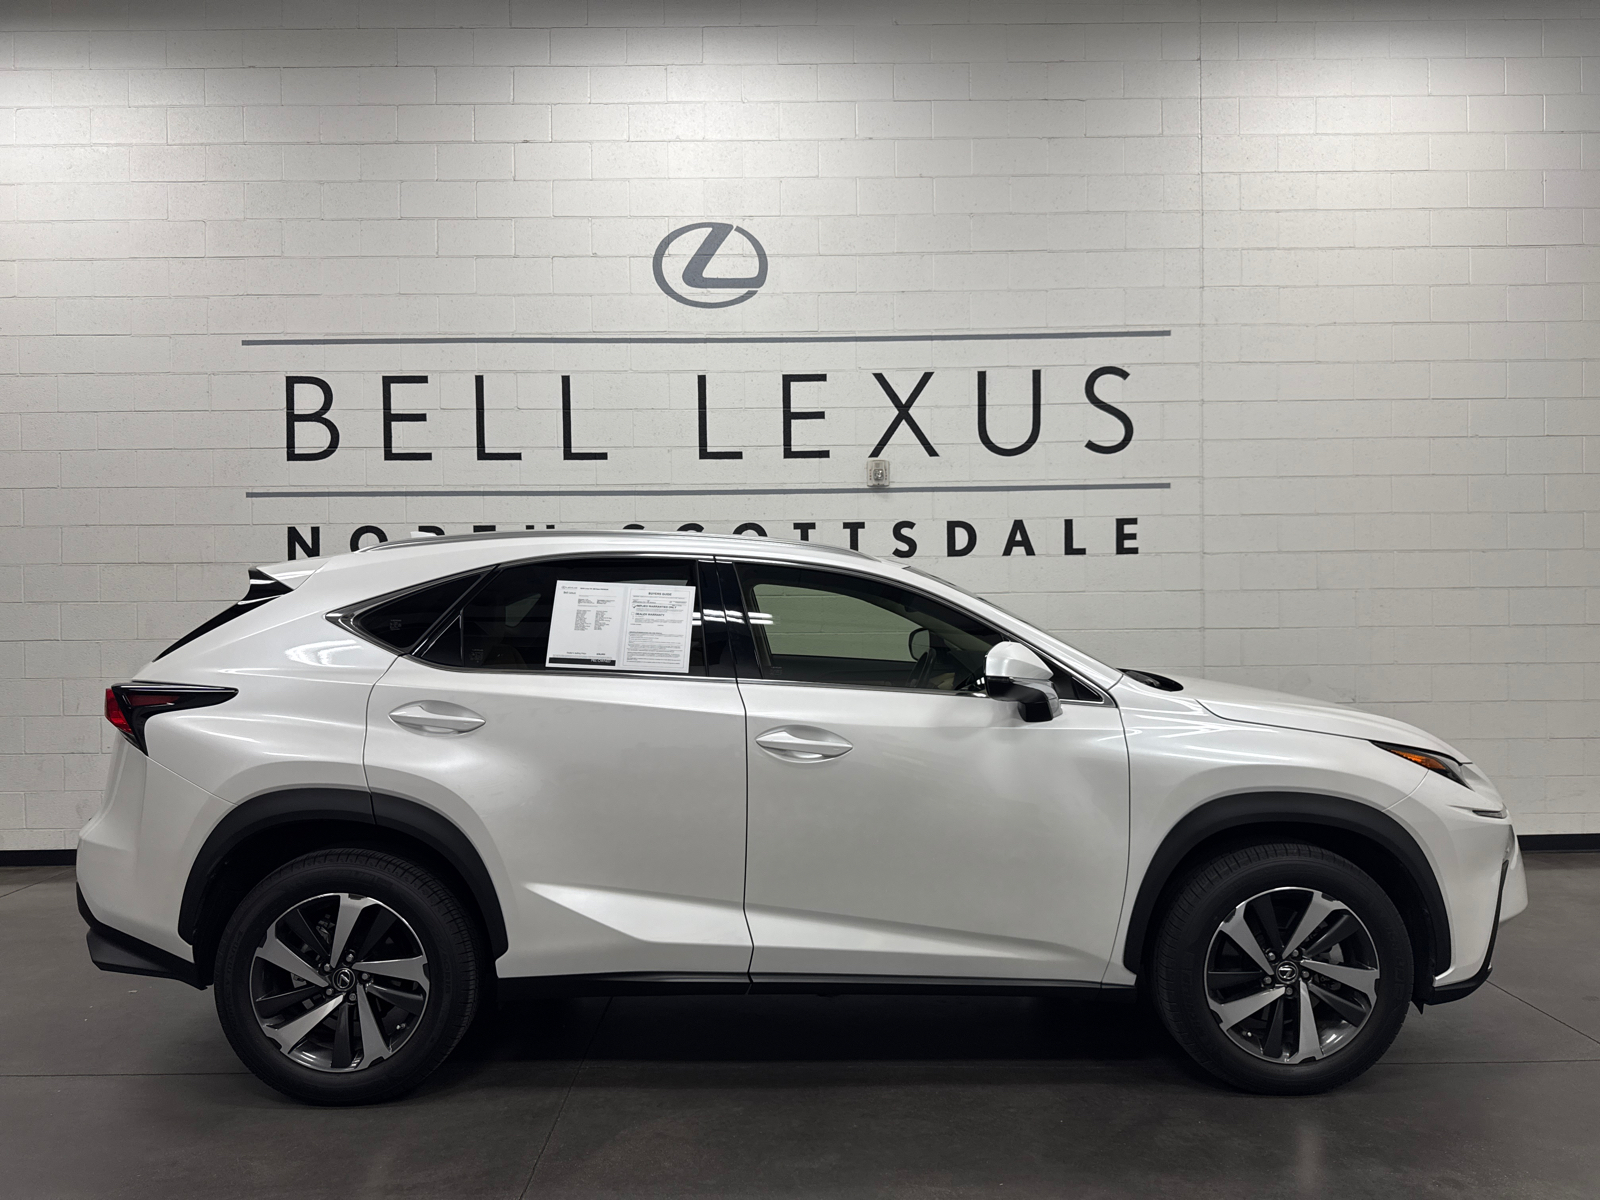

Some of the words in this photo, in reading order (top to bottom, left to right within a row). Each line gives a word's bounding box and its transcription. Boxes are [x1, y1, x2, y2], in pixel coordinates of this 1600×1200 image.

[286, 375, 607, 461] BELL
[698, 367, 1133, 459] LEXUS
[622, 517, 1139, 558] TTSDALE
